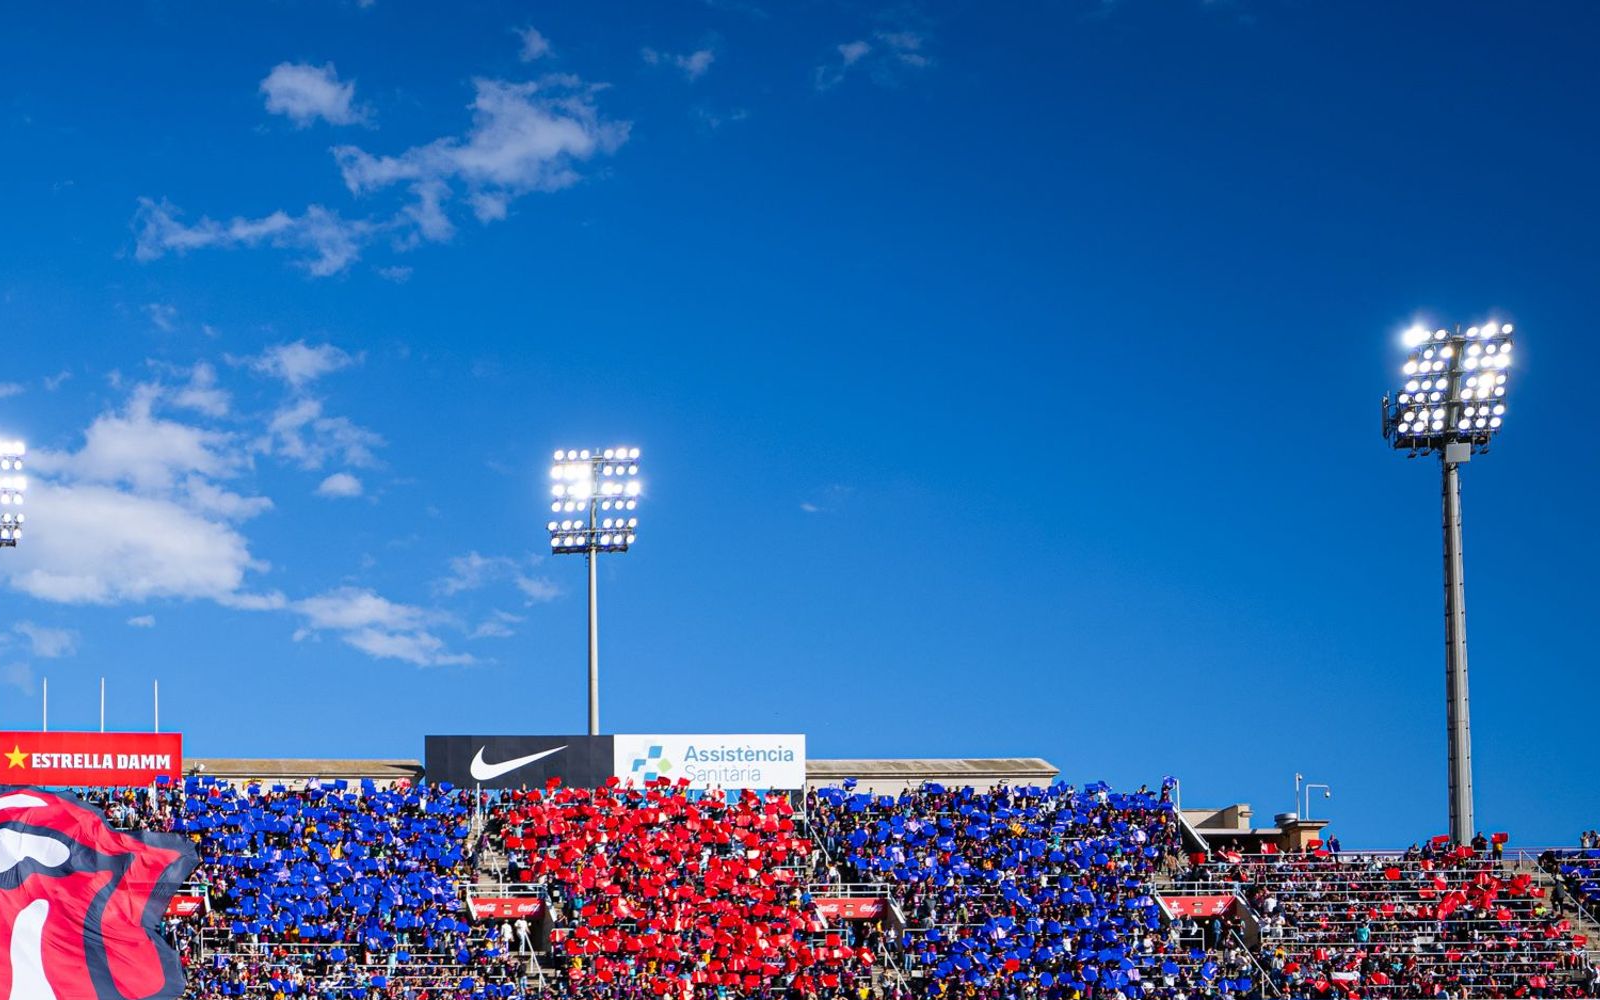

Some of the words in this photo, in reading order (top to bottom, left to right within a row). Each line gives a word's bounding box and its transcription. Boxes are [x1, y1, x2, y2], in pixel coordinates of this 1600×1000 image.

[31, 753, 113, 769] ESTRELLA
[117, 754, 171, 770] DAMM
[684, 745, 794, 762] Assistència
[684, 764, 761, 783] Sanitària
